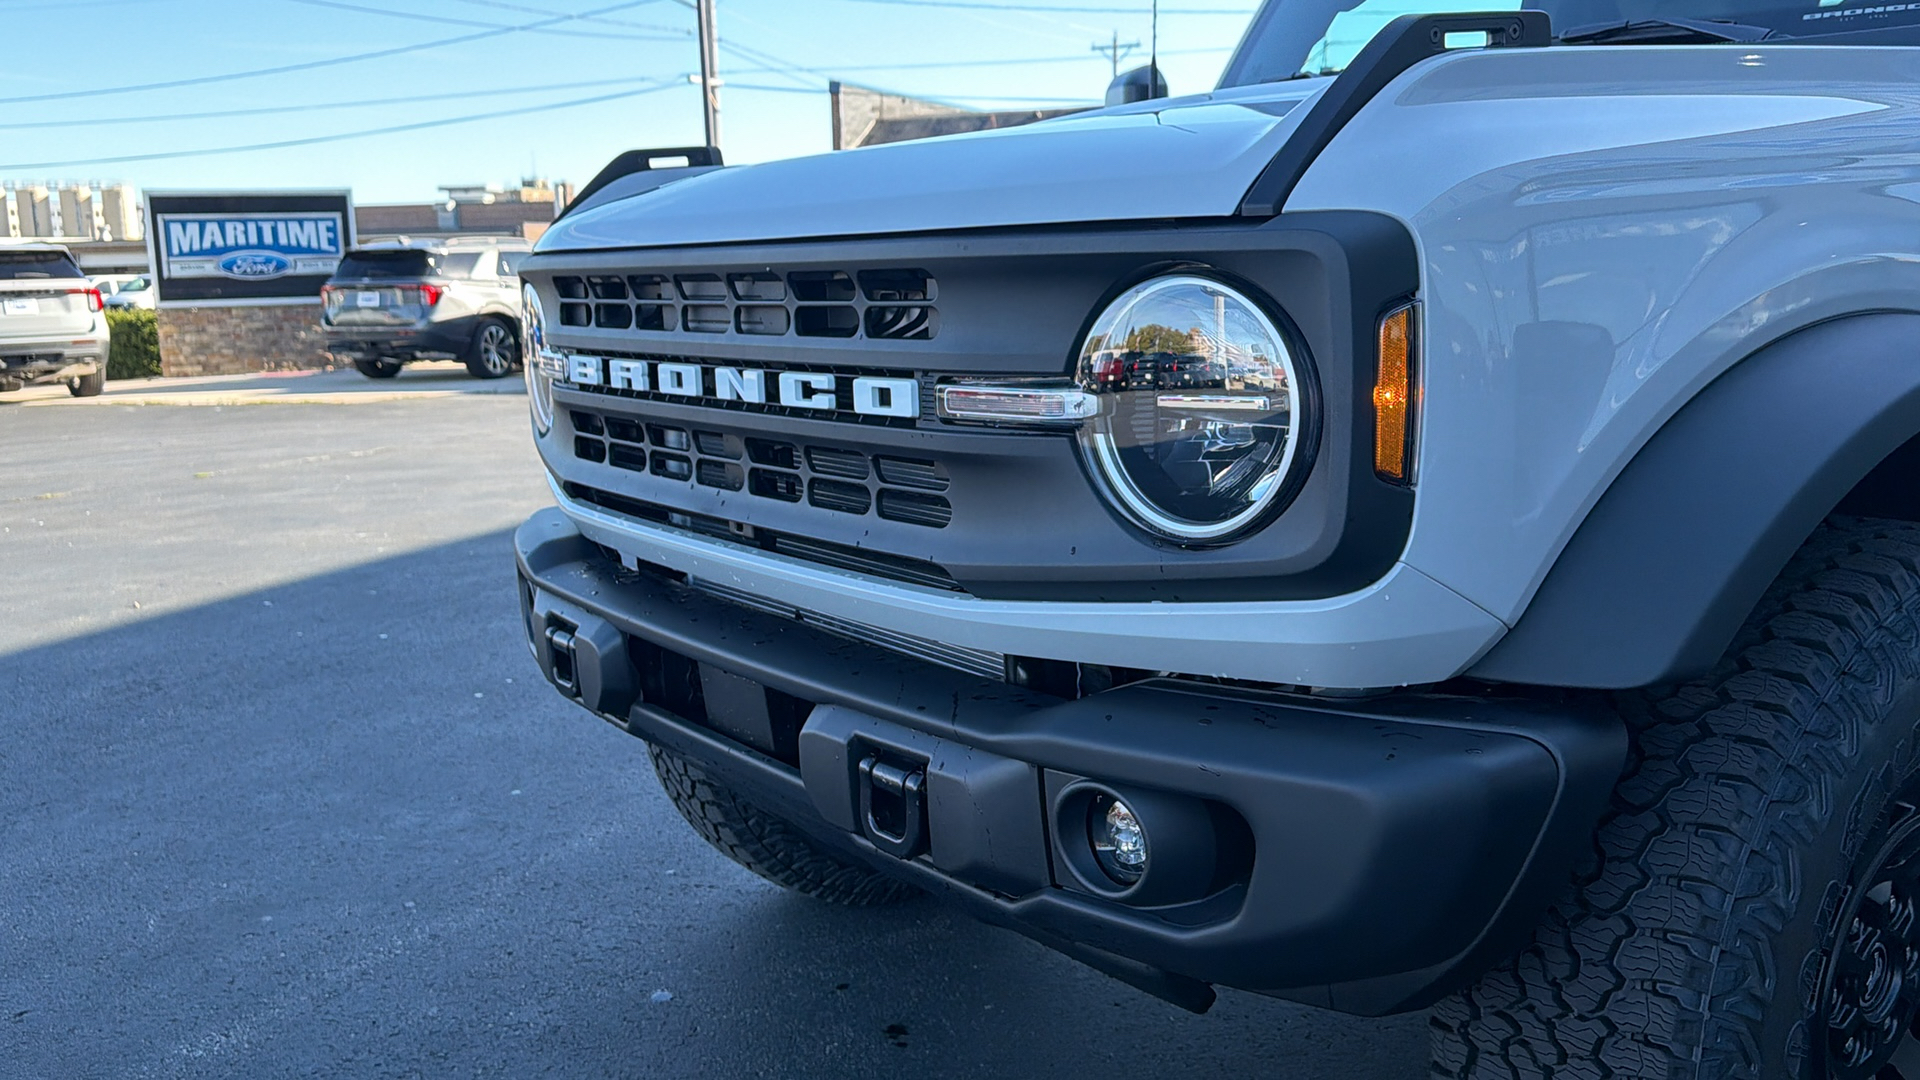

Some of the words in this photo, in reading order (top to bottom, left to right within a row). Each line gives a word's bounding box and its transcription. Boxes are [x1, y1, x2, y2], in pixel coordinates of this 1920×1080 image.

[1803, 3, 1920, 20] BRONCO
[169, 220, 337, 256] MARITIME
[233, 256, 277, 275] Ford
[568, 354, 920, 419] BRONCO
